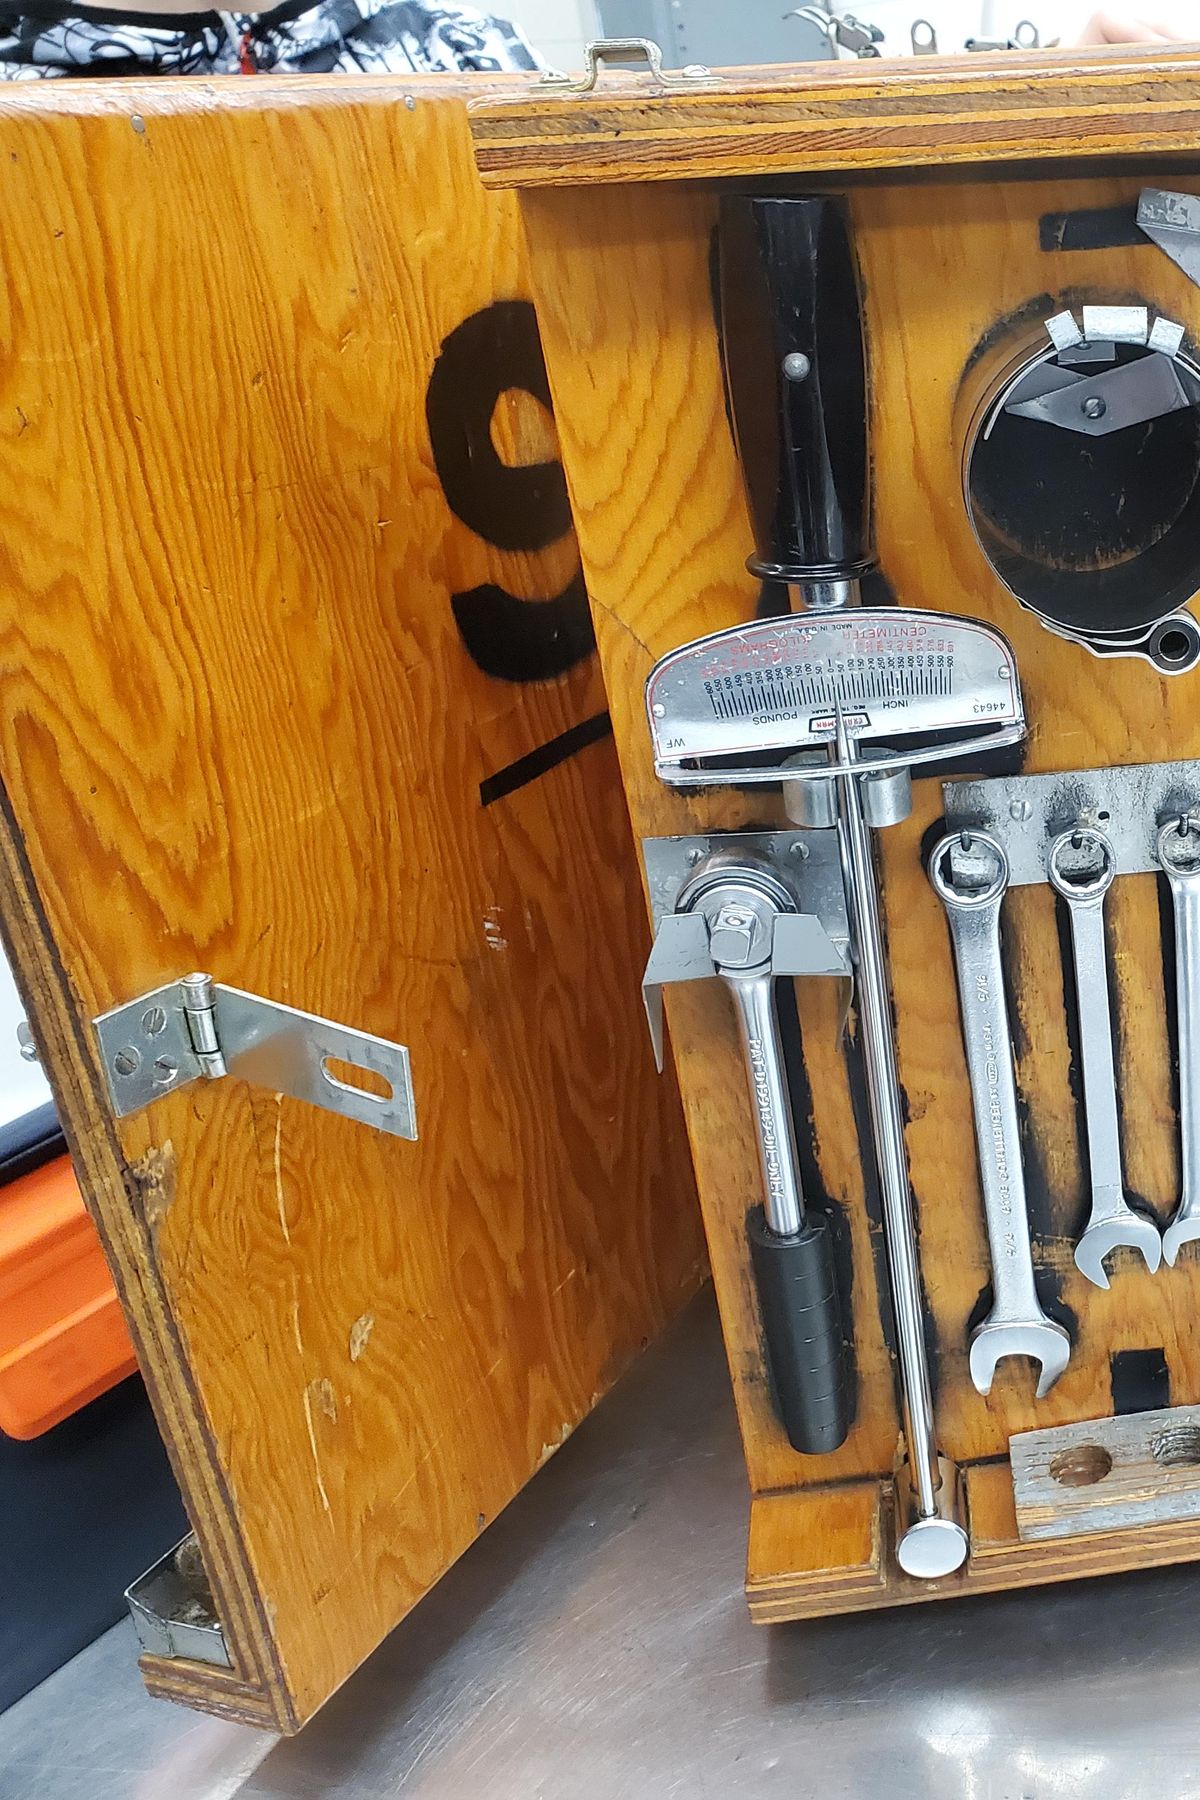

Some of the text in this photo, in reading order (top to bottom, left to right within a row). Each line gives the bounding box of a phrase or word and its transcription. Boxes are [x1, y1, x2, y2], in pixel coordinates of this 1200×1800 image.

[843, 627, 927, 639] CENTIMETER
[877, 658, 886, 669] 250
[897, 656, 905, 668] 350
[907, 656, 915, 668] 400
[927, 655, 935, 667] 500
[775, 668, 783, 680] 250
[805, 664, 813, 676] 100
[815, 666, 822, 674] 50
[838, 664, 845, 672] 50
[735, 675, 743, 687] 450
[745, 672, 753, 685] 400
[755, 671, 763, 684] 350
[765, 669, 774, 681] 300
[704, 681, 713, 694] 600
[714, 679, 723, 691] 550
[724, 677, 733, 689] 500
[883, 701, 908, 709] INCH
[973, 704, 1006, 713] 44643
[753, 712, 798, 725] POUNDS
[667, 738, 685, 749] WF
